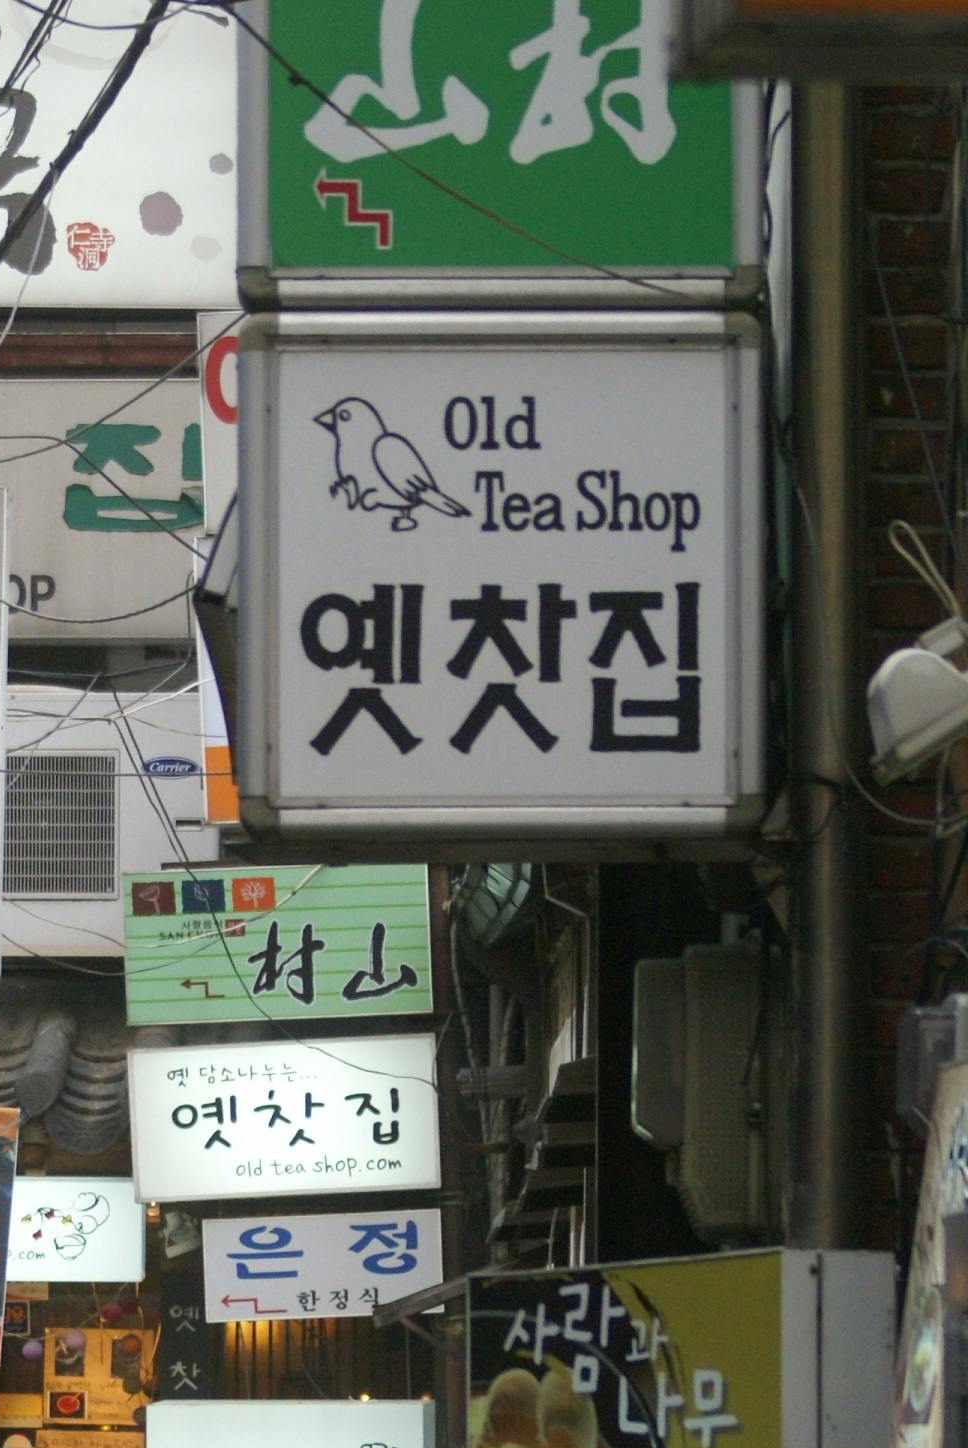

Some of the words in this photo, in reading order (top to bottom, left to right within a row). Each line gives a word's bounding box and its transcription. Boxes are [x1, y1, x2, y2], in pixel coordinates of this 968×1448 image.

[443, 396, 541, 450] Old
[475, 471, 564, 533] Tea
[576, 471, 701, 552] Shop
[299, 583, 701, 756] 옛찻집
[150, 762, 191, 773] Carrier
[171, 1088, 400, 1149] 옛찻집
[236, 1157, 263, 1177] old
[271, 1159, 306, 1174] tea
[297, 1287, 382, 1312] 한정식
[504, 1283, 669, 1394] 사람과
